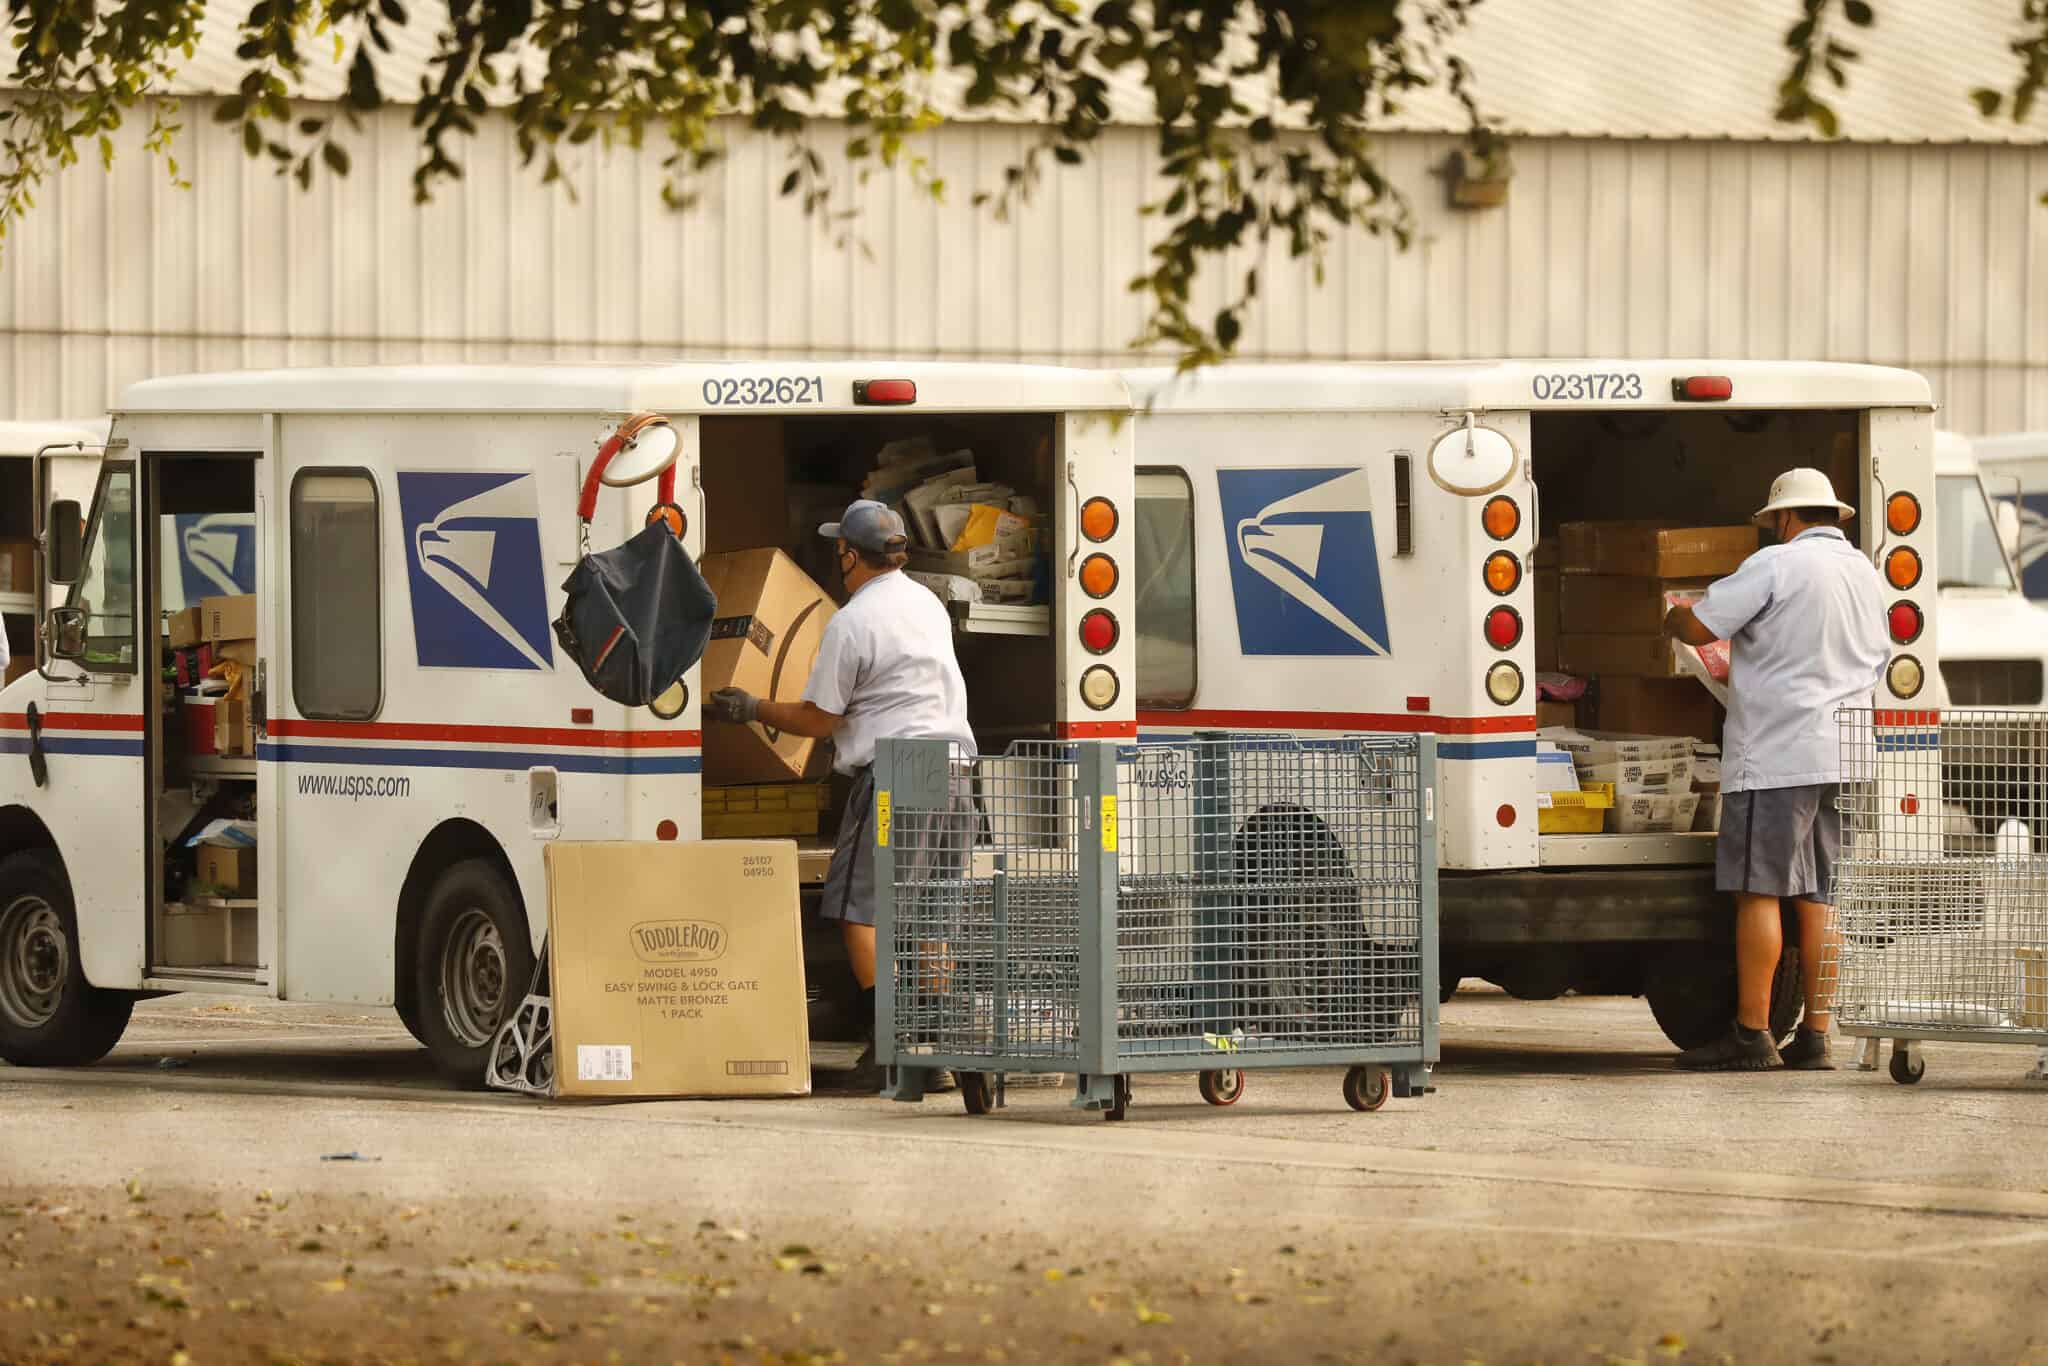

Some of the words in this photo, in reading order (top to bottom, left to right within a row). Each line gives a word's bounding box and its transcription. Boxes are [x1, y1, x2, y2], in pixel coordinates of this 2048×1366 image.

[703, 376, 823, 405] 0232621
[1533, 374, 1642, 400] 0231723
[298, 775, 410, 802] www.usps.com
[644, 967, 686, 978] MODEL
[690, 967, 718, 977] 4950
[605, 983, 634, 993] EASY
[638, 982, 677, 992] SWING
[681, 981, 689, 992] &
[693, 981, 725, 992] LOCK
[728, 980, 759, 991] GATE
[638, 995, 677, 1006] MATTE
[680, 994, 728, 1005] BRONZE
[661, 1008, 667, 1019] 1
[671, 1008, 703, 1019] PACK
